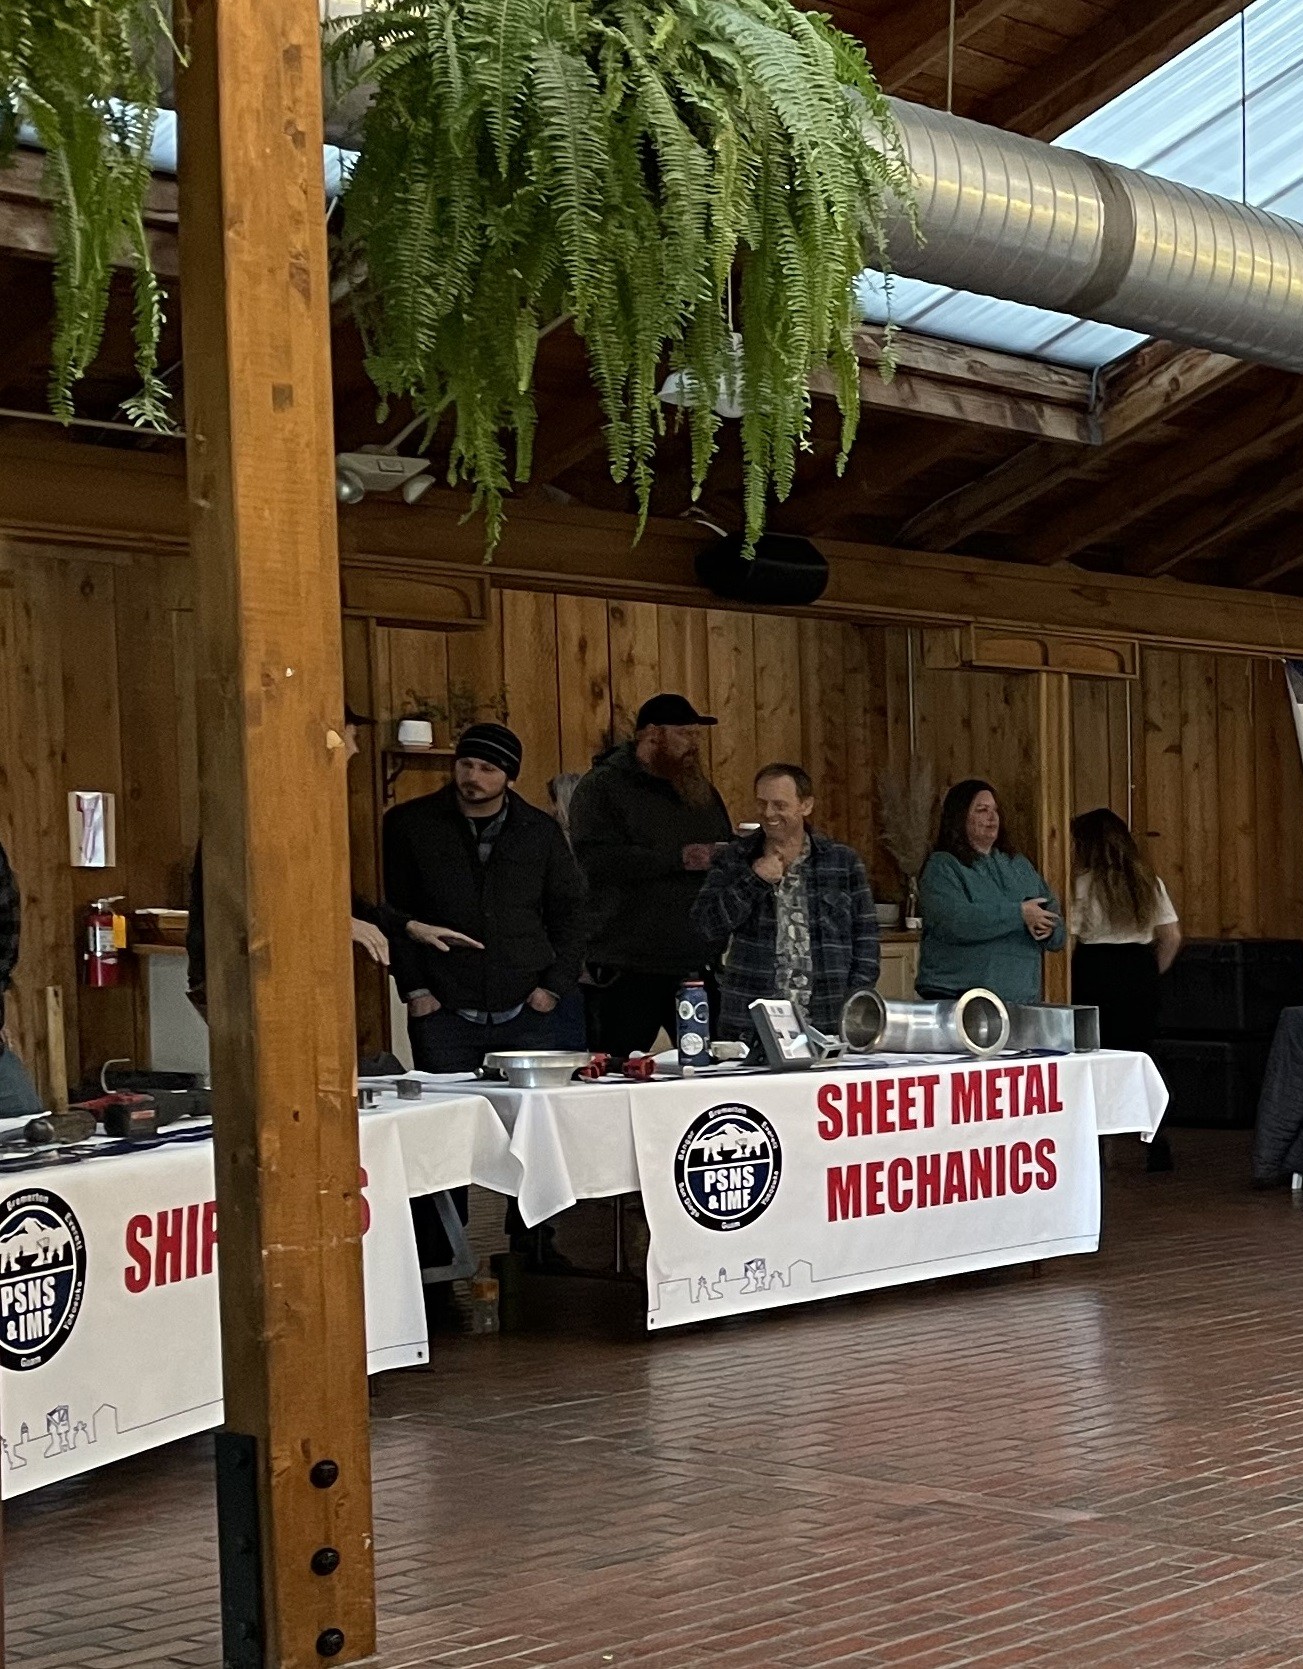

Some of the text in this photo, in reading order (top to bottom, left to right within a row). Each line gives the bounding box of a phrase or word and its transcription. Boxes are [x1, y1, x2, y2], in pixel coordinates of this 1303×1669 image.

[817, 1062, 1063, 1141] SHEET METAL
[703, 1165, 755, 1193] PSNS
[827, 1138, 1057, 1222] MECHANICS
[124, 1200, 219, 1293] SHIP
[1, 1276, 56, 1317] PSNS
